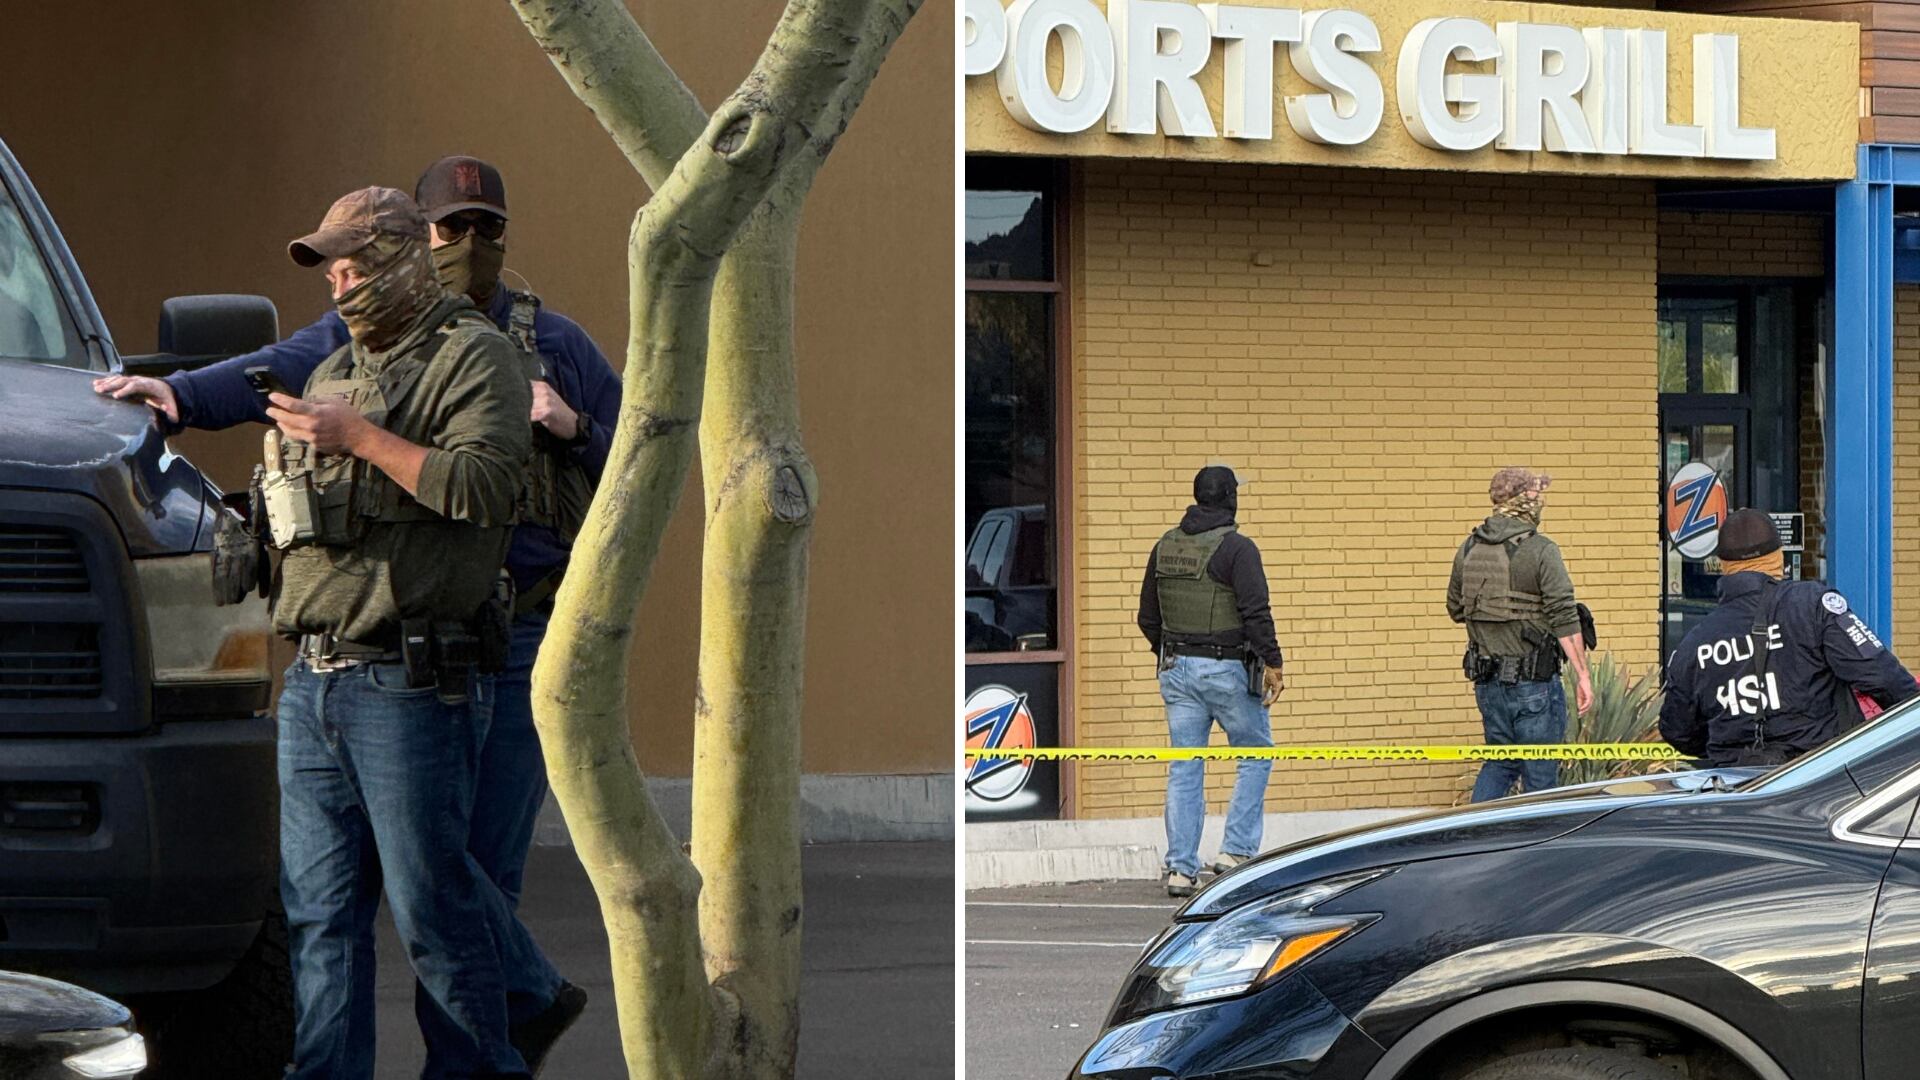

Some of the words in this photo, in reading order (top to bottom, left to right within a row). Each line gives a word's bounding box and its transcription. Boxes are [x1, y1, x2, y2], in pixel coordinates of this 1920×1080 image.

[1396, 16, 1777, 160] GRILL
[1697, 624, 1784, 669] POLIE
[1846, 625, 1868, 646] HSI
[1848, 614, 1883, 648] POLICE
